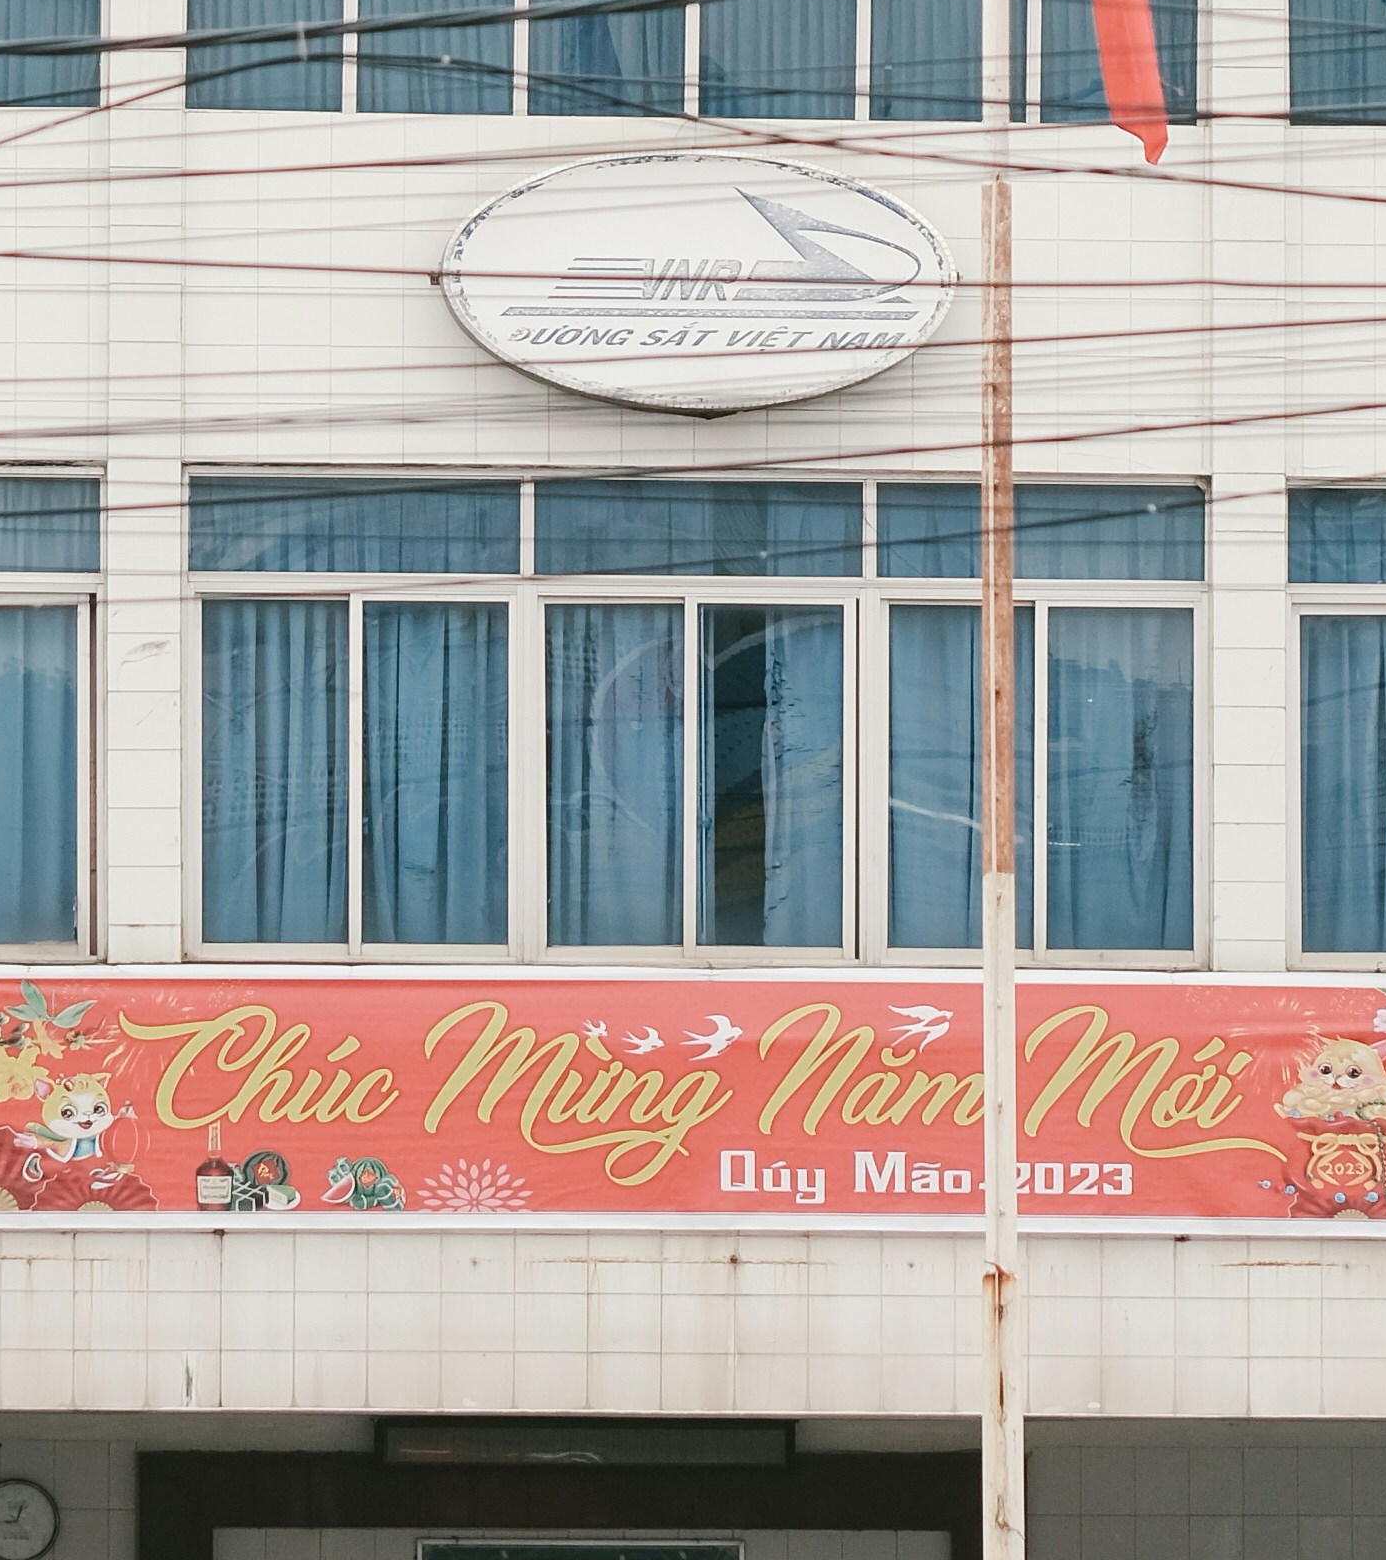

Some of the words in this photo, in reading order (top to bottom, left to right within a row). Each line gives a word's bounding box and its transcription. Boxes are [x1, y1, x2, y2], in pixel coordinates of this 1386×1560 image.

[642, 258, 742, 301] VNR
[639, 320, 720, 347] SẮT
[726, 325, 814, 352] VIỆT
[816, 330, 907, 350] NAM
[118, 1004, 400, 1130] Chúc
[423, 1000, 734, 1186] Mừng
[758, 1001, 985, 1136] Năm
[1023, 1004, 1288, 1164] Mới
[1325, 1162, 1366, 1176] 2023
